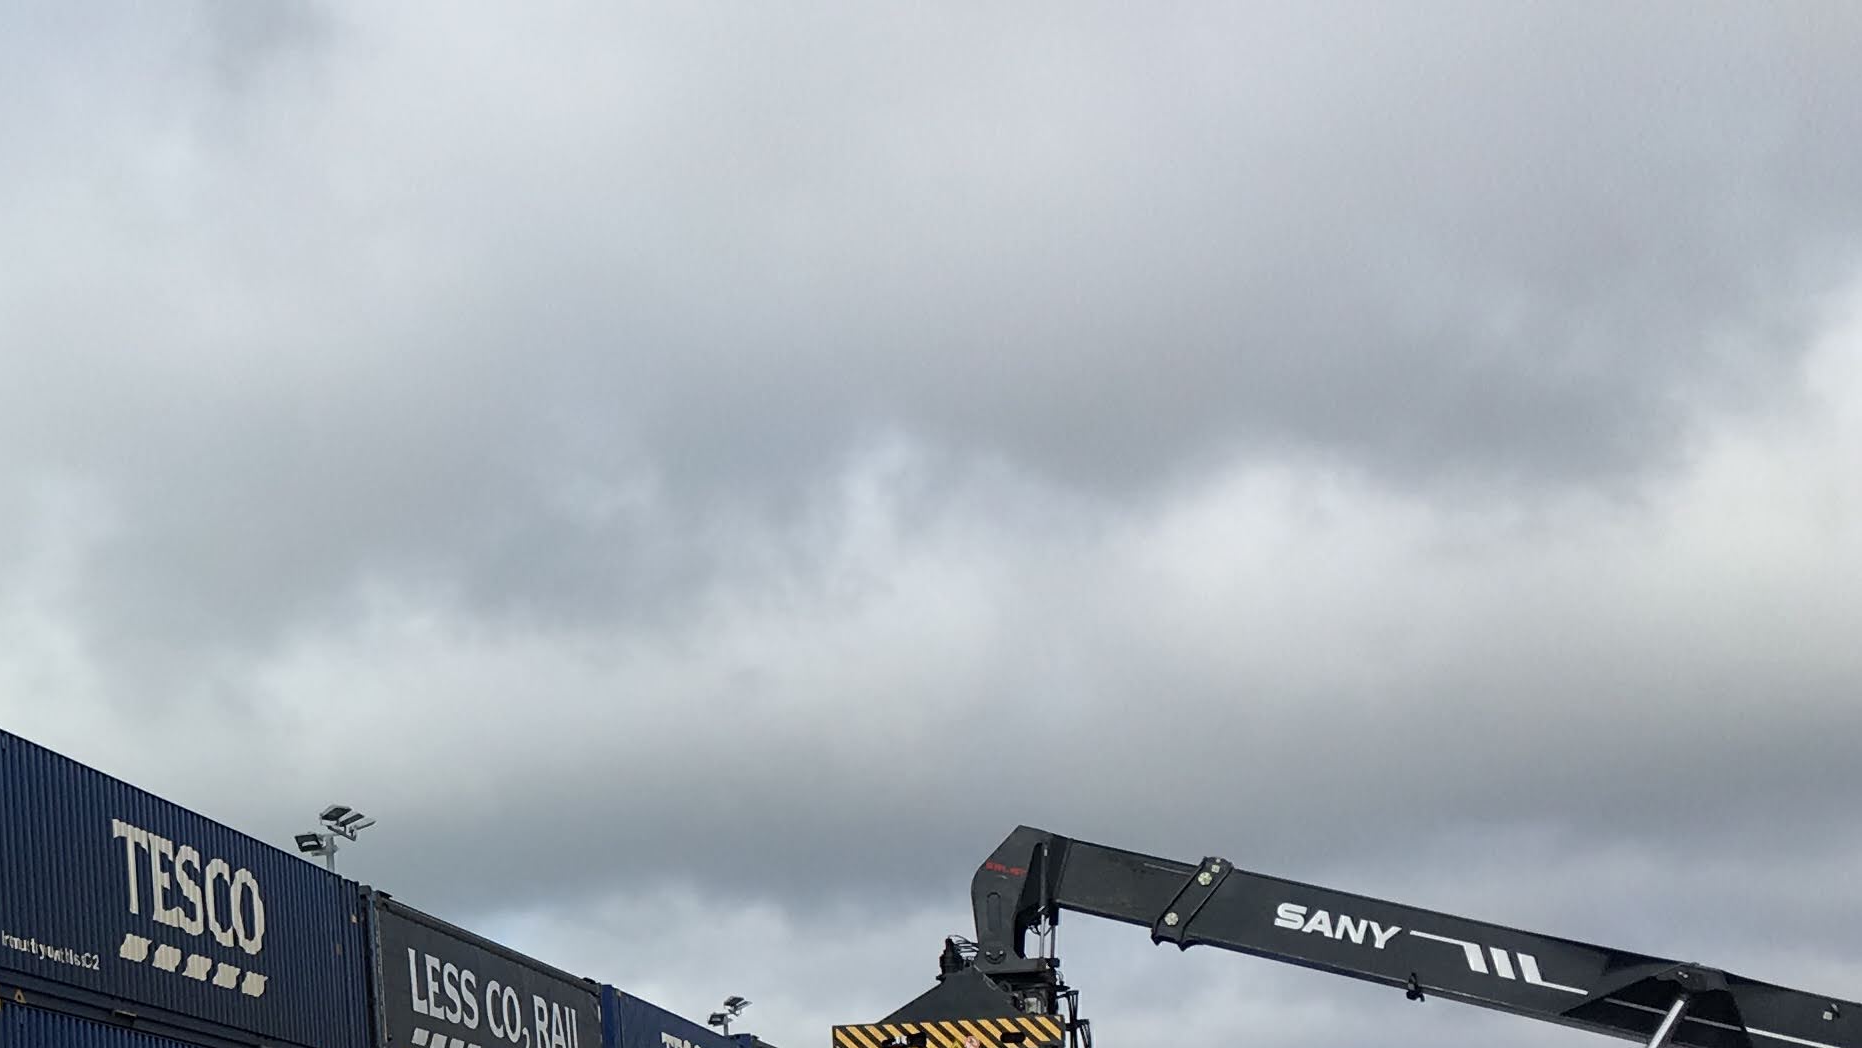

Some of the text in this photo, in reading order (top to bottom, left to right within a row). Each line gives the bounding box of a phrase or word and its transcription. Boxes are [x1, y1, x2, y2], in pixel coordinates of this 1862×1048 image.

[112, 819, 265, 955] TESCO
[1274, 902, 1402, 949] SANY
[408, 947, 479, 1029] LESS
